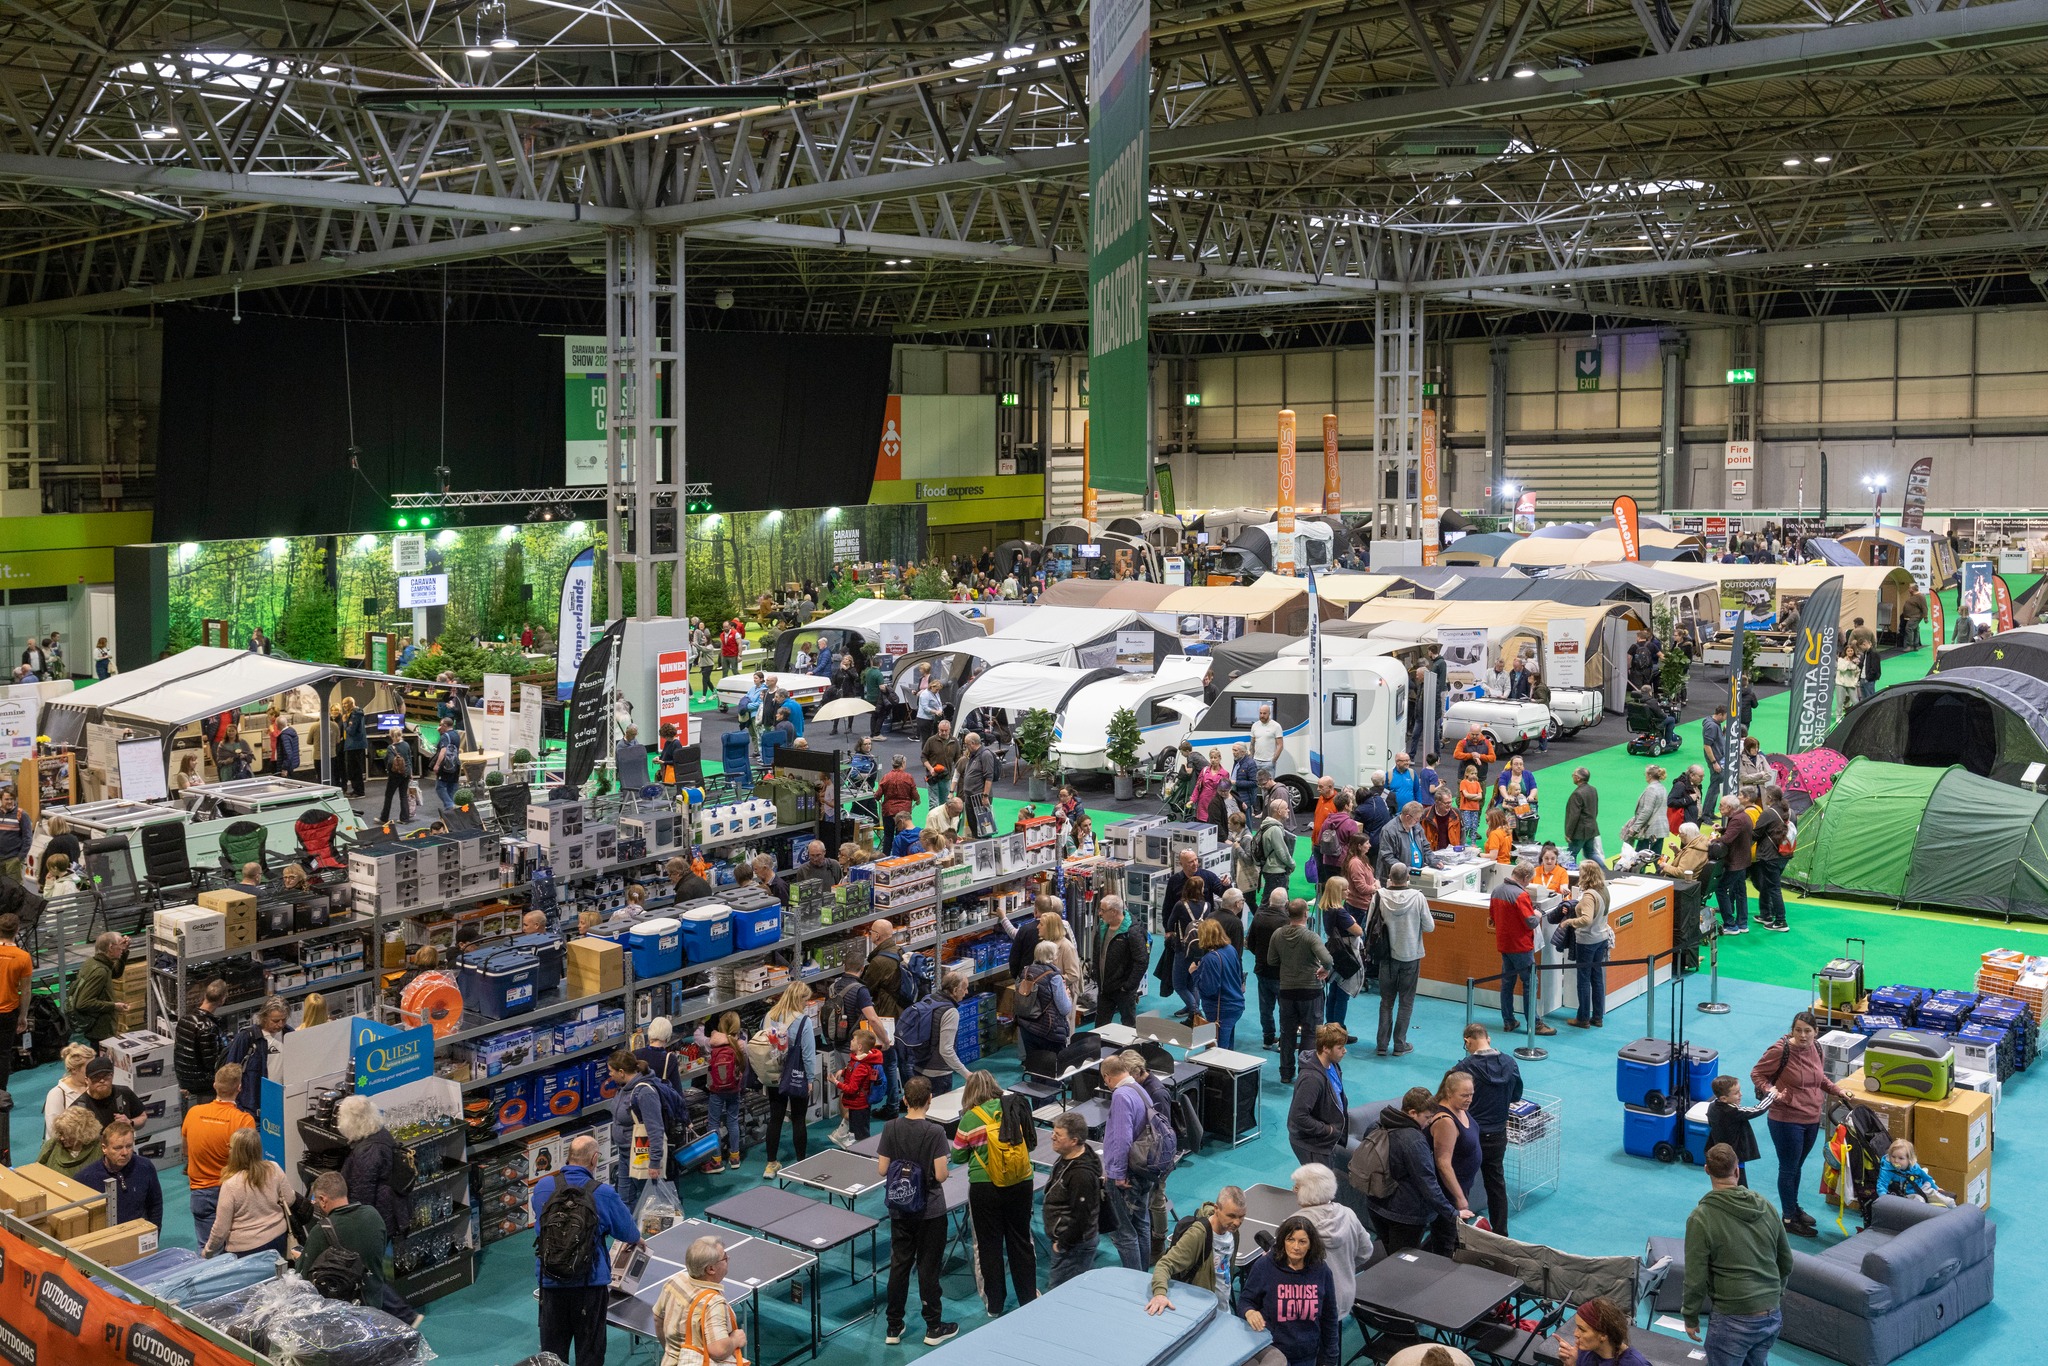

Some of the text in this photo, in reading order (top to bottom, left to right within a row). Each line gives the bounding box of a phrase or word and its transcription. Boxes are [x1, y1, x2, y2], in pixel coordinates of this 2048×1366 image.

[572, 345, 595, 354] CARAVAN
[572, 355, 594, 366] SHOW
[1580, 378, 1597, 389] EXIT
[1281, 427, 1293, 492] OPUS
[1327, 429, 1337, 482] OPUS
[1424, 424, 1436, 482] OPUS
[1727, 456, 1751, 464] point
[1002, 462, 1013, 471] Fire
[411, 578, 436, 586] CARAVAN
[572, 578, 584, 669] Camperlands
[660, 661, 686, 674] WINNER
[661, 687, 686, 696] Camping
[1814, 627, 1834, 747] GREAT OUTDOORS
[1800, 668, 1818, 747] REGATTA
[520, 1034, 532, 1044] Set
[24, 1269, 38, 1297] PJ
[42, 1280, 83, 1320] OUTDOORS
[406, 1272, 462, 1300] www.questleisure.com
[1278, 1284, 1318, 1299] CHOOSE
[1278, 1300, 1318, 1322] LOVE
[105, 1322, 190, 1366] PJ OUTDOORS
